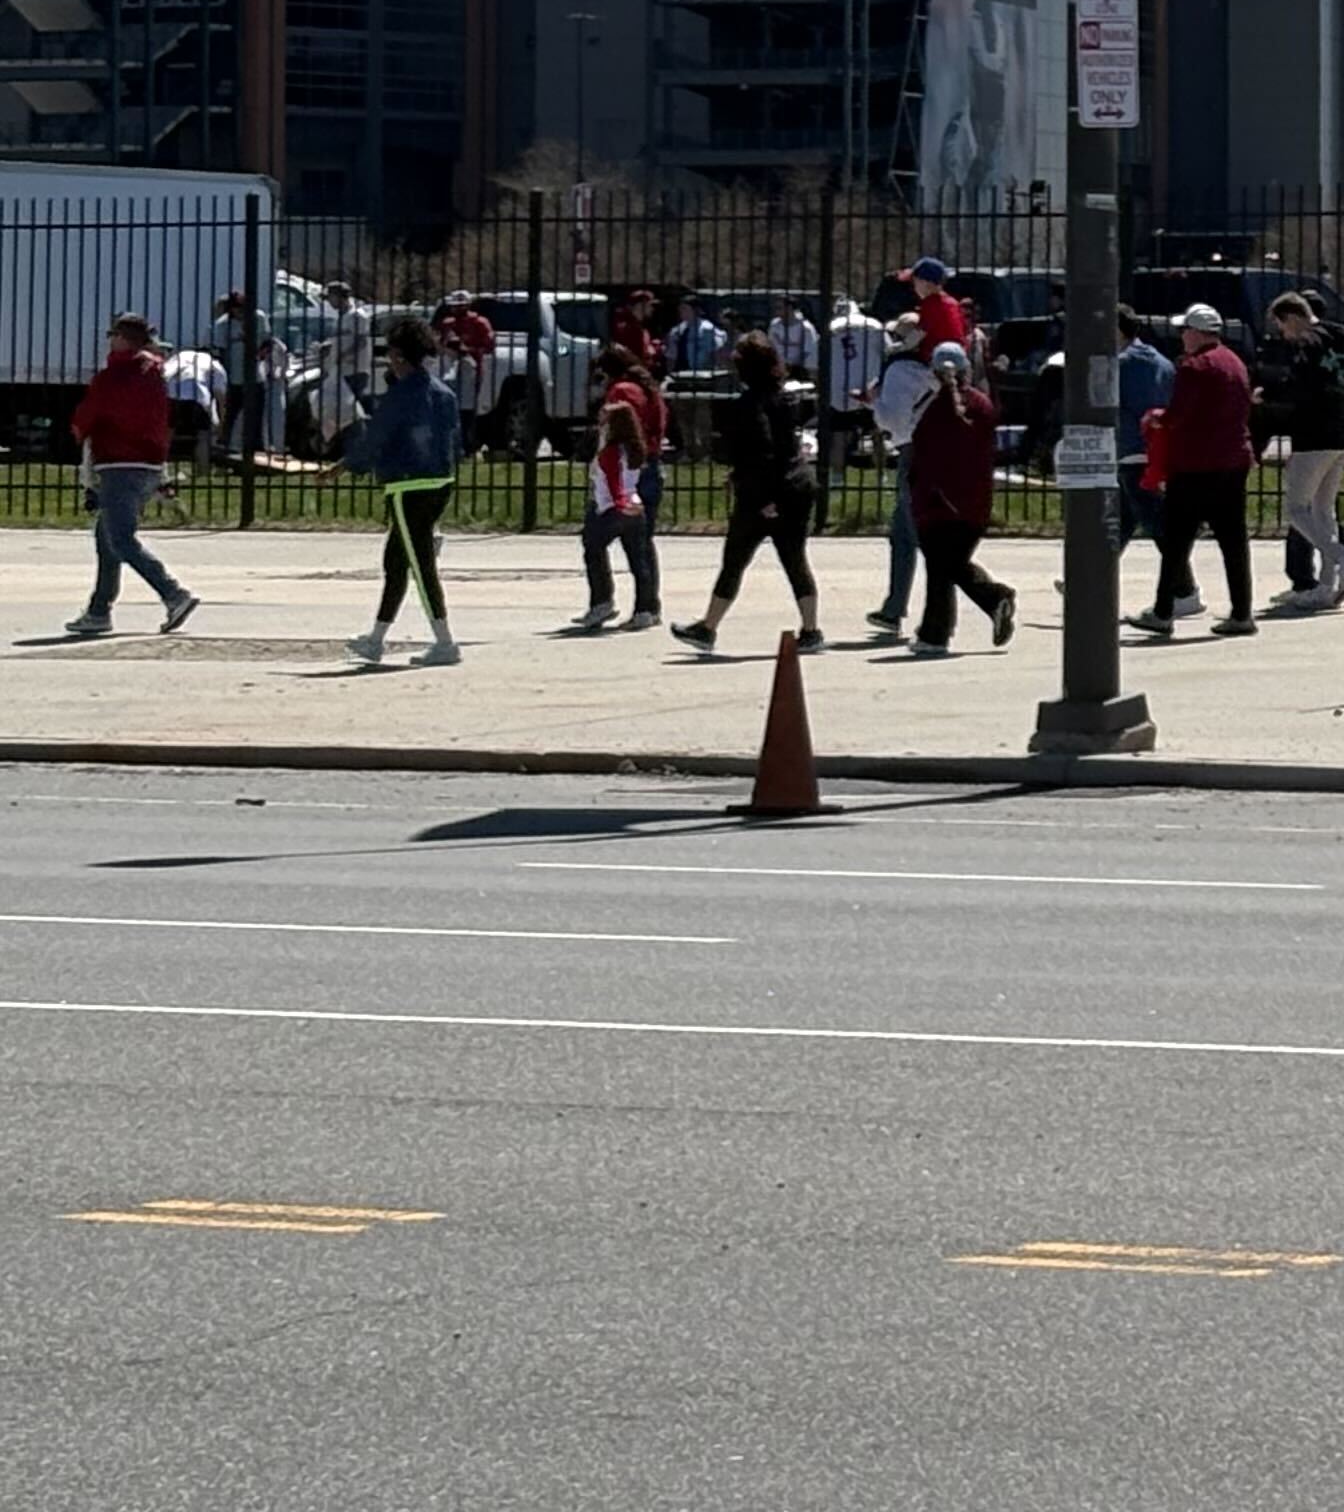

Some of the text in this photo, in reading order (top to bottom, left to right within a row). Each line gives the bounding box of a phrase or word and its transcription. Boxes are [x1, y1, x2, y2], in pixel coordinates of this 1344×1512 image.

[1081, 24, 1134, 47] NO PARKING
[1086, 71, 1132, 86] VEHICLES
[1089, 90, 1127, 105] ONLY
[841, 335, 858, 361] 5
[1063, 437, 1102, 451] POLICE
